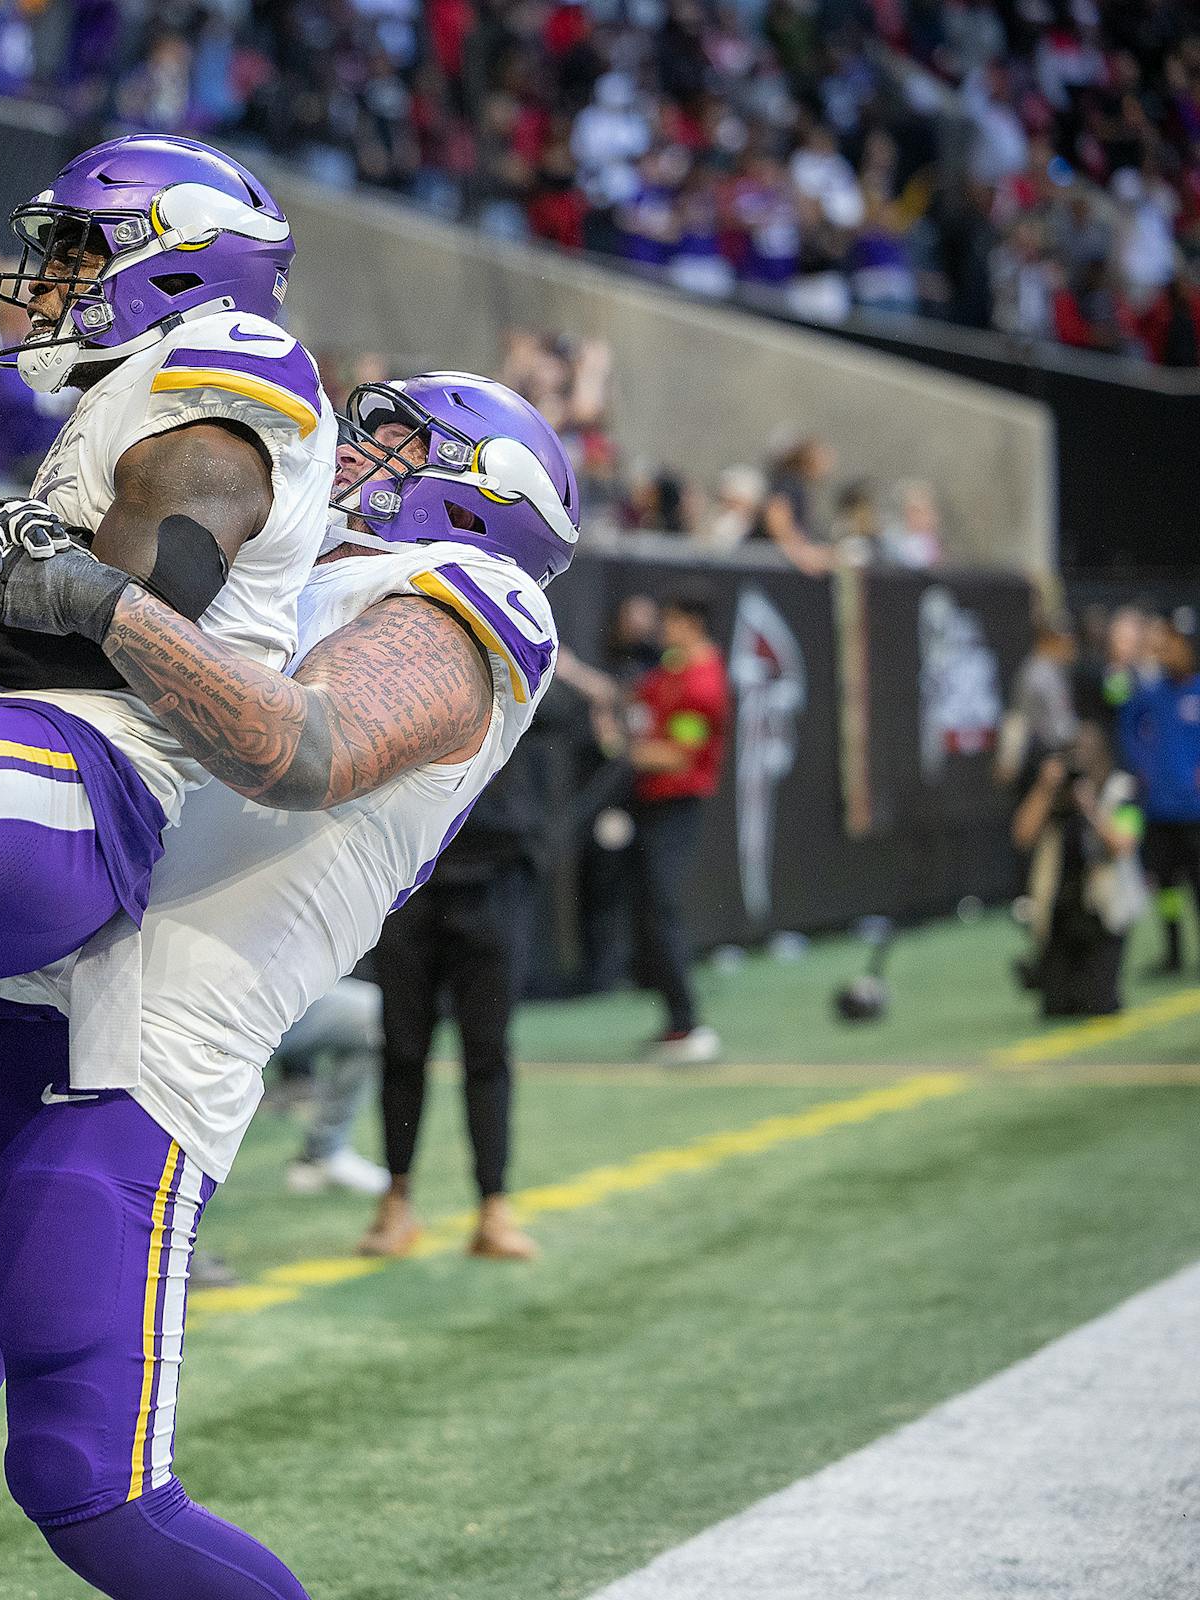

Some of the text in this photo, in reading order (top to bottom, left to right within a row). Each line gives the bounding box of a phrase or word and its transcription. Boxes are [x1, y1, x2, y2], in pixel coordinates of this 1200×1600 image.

[117, 624, 157, 651] against
[155, 647, 174, 663] the
[172, 660, 203, 686] devil's
[129, 611, 143, 622] So
[142, 619, 161, 634] that
[159, 632, 175, 646] you
[175, 644, 189, 656] can
[205, 668, 225, 684] your
[220, 663, 230, 672] of
